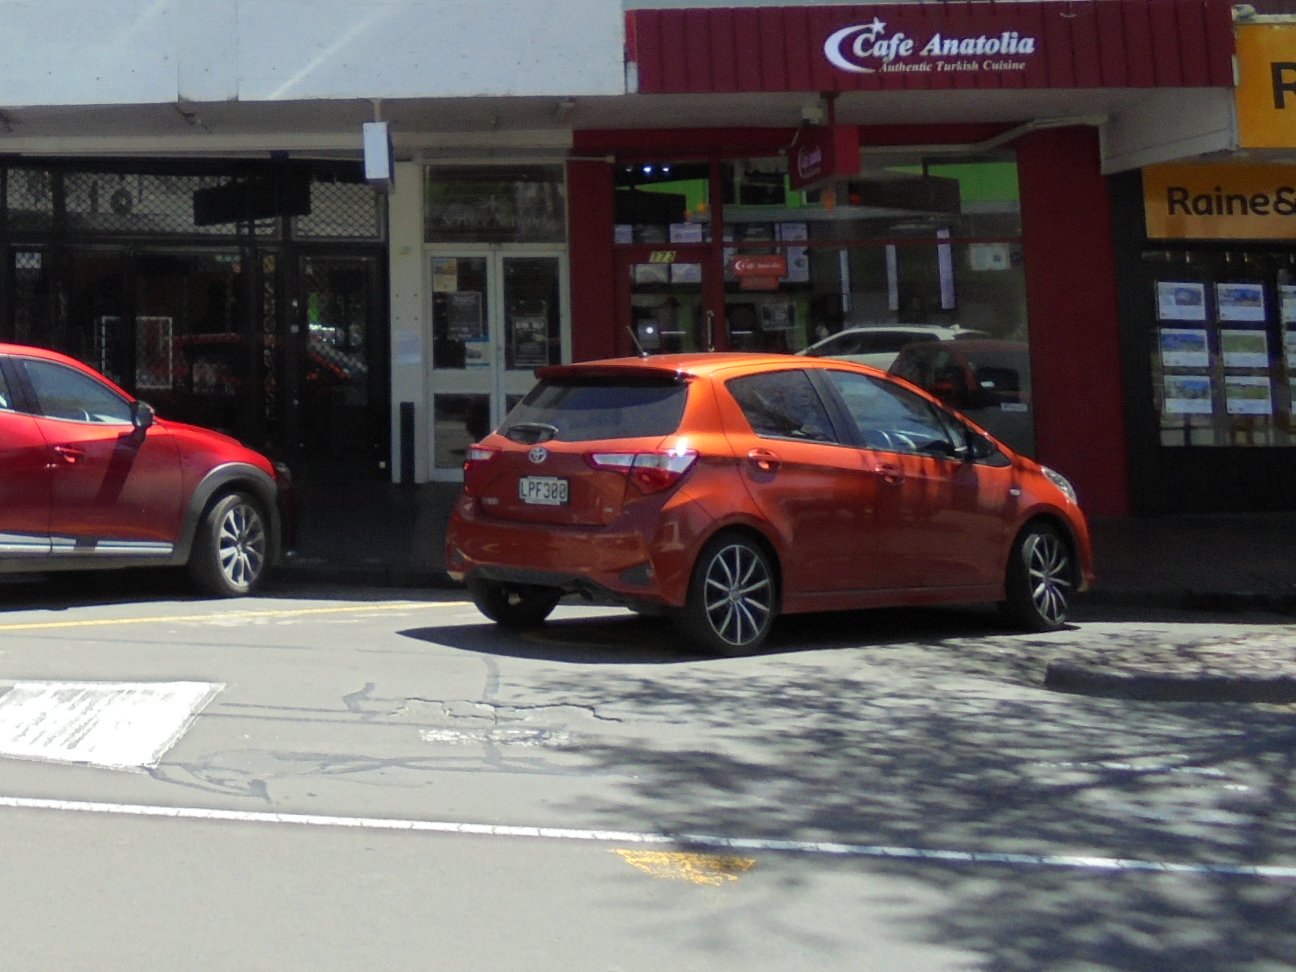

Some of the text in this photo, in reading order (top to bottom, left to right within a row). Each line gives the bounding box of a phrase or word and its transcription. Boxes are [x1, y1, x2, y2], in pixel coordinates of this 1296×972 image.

[853, 31, 1036, 63] Cafe Anatolia
[879, 59, 1027, 73] Authentic Turkish Cuisine
[520, 481, 567, 499] LPF300
